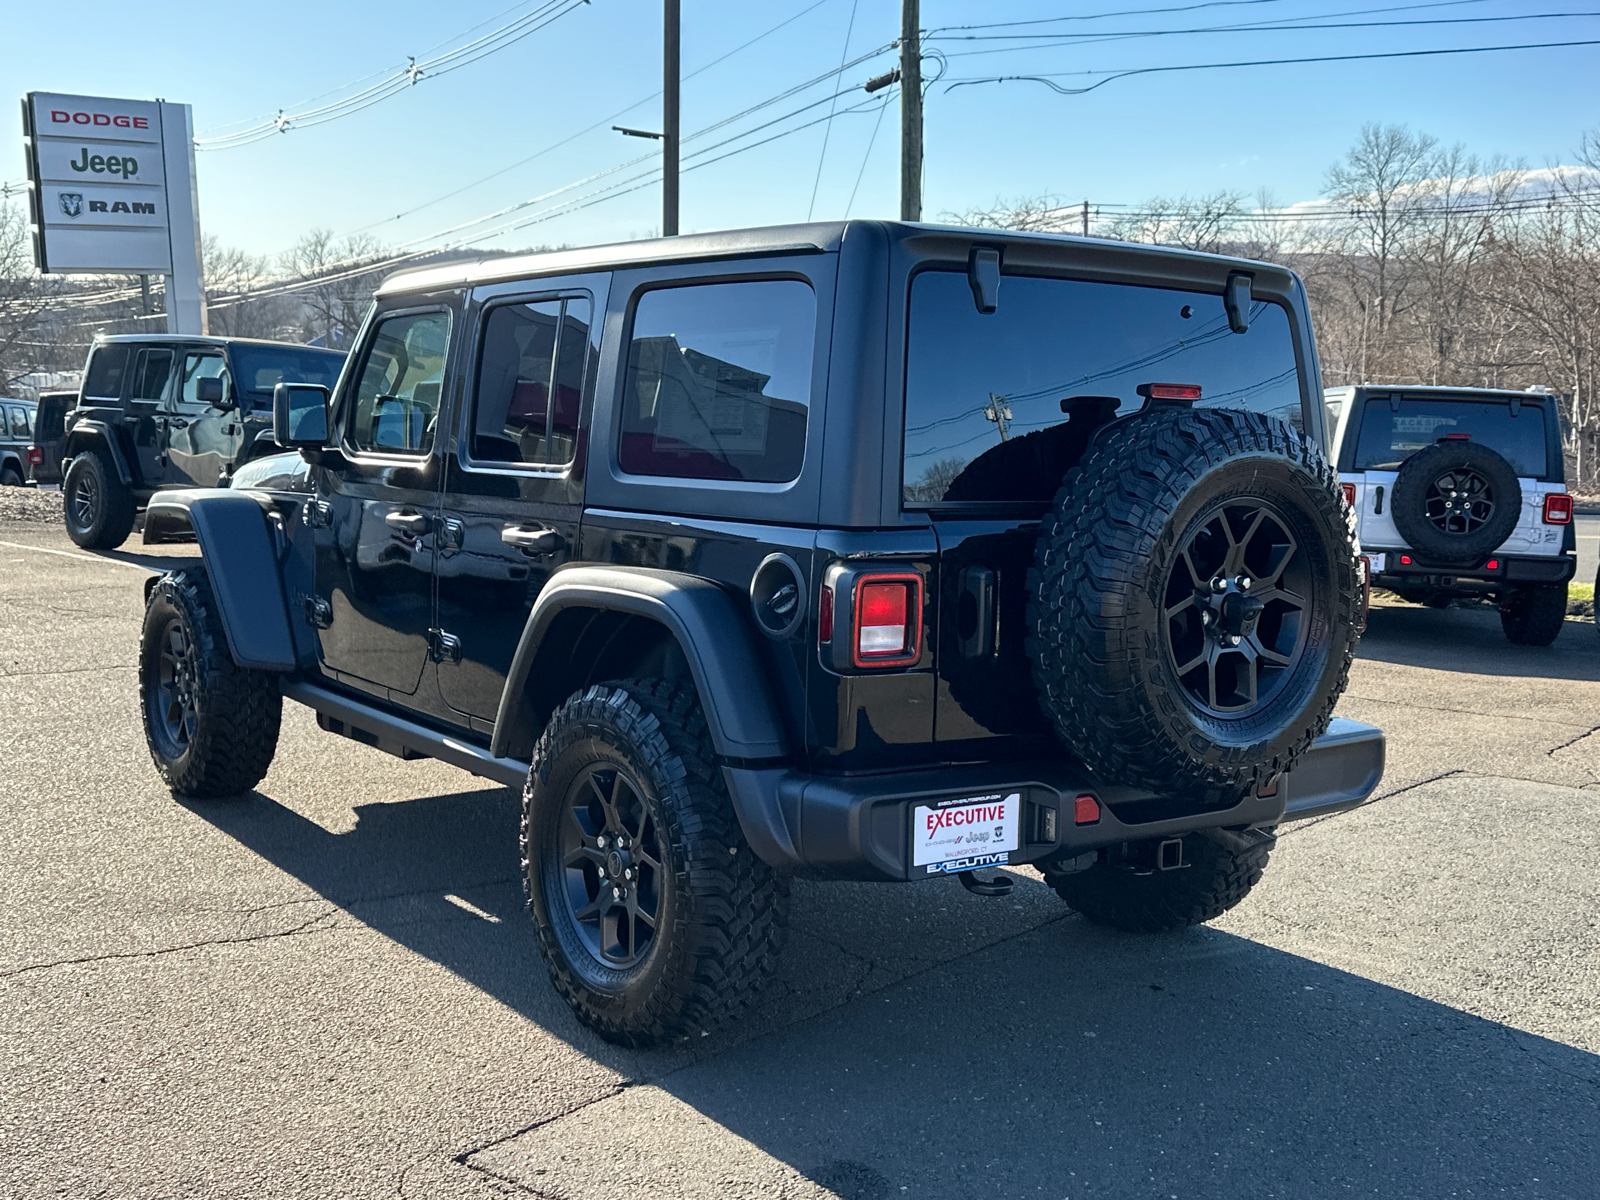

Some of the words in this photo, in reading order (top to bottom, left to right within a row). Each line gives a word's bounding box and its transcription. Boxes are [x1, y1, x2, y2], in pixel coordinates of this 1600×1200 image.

[51, 110, 149, 130] DODGE
[70, 147, 138, 180] Jeep
[88, 200, 156, 214] RAM
[926, 805, 1005, 840] EXECUTIVE
[965, 831, 990, 844] Jeep
[926, 852, 1009, 874] EXECUTIVE
